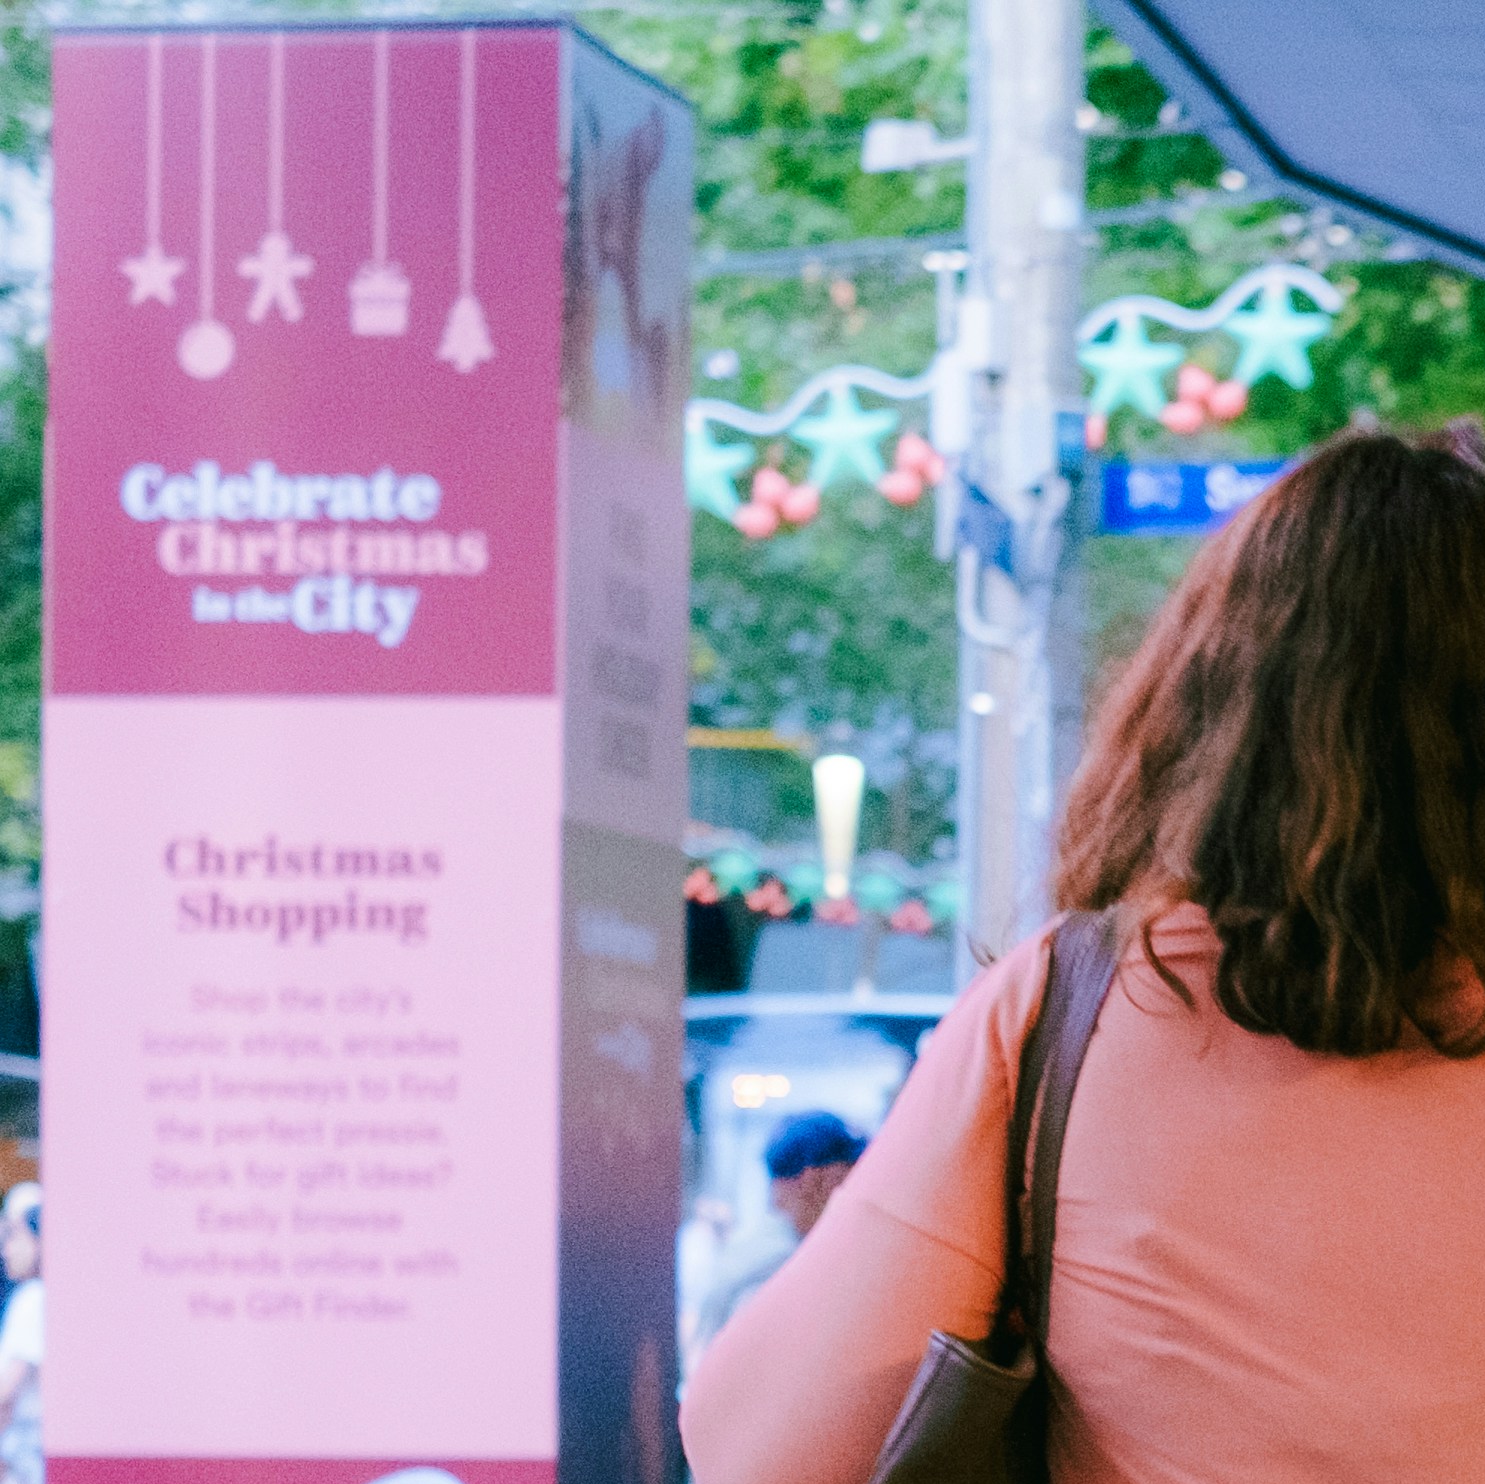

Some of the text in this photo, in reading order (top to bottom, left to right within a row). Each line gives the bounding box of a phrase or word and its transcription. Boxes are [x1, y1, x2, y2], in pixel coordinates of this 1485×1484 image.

[120, 460, 441, 522] Celebrate
[157, 522, 489, 577] Christmas
[291, 574, 421, 648] City
[163, 834, 444, 880] Christmas
[176, 890, 431, 946] Shopping
